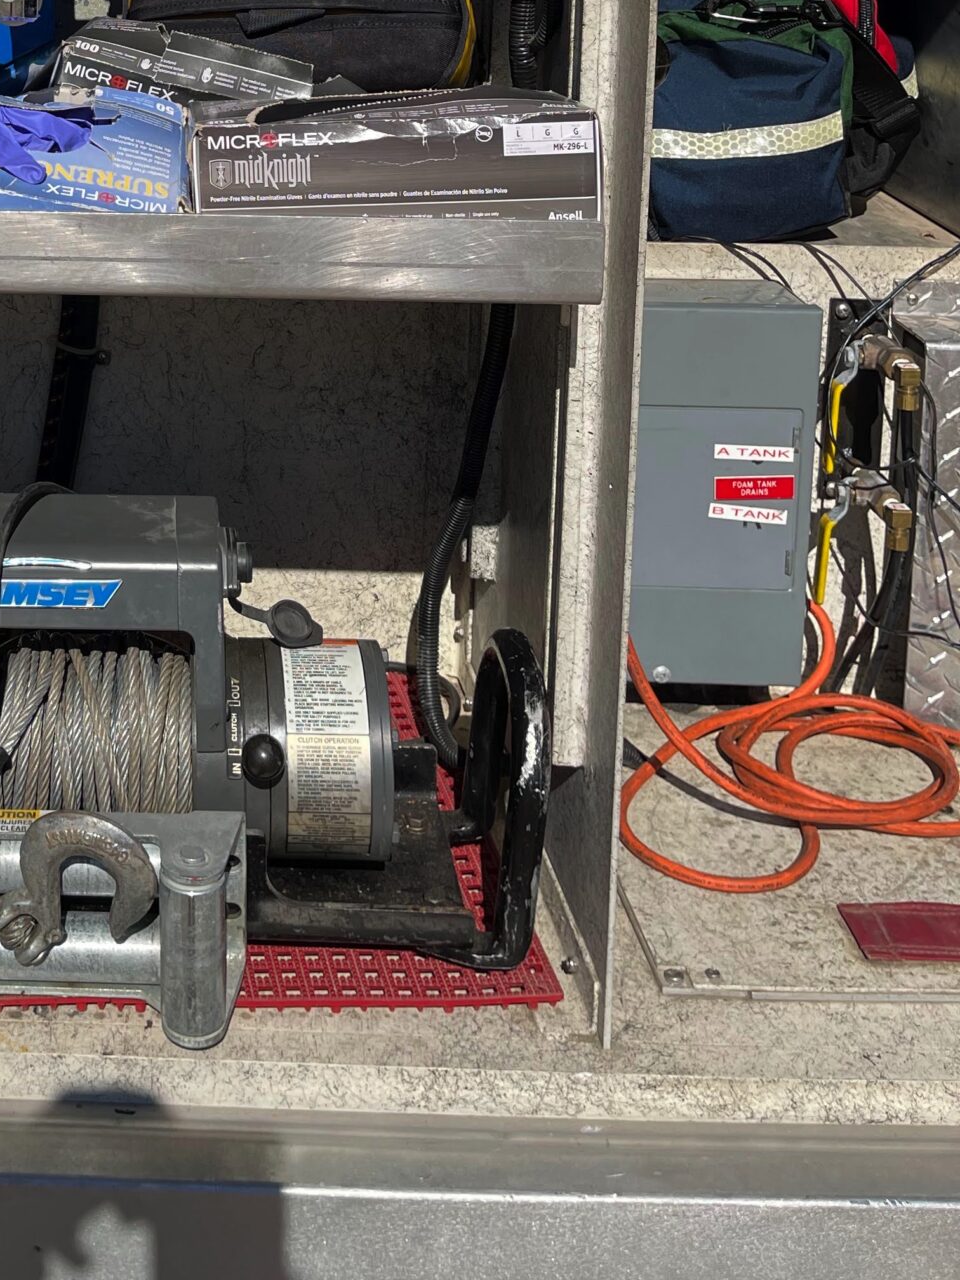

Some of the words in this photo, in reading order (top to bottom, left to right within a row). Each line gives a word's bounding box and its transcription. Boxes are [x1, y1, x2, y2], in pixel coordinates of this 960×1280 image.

[75, 40, 100, 53] 100
[64, 61, 175, 103] MICROFLEX
[156, 102, 176, 115] 50
[516, 130, 520, 138] L
[544, 128, 550, 136] G
[207, 131, 334, 150] MICROFLEX
[553, 142, 588, 151] MK-296-L
[45, 183, 167, 213] MICROFLEX
[548, 210, 584, 220] Ansell
[717, 447, 730, 456] A
[736, 448, 790, 458] TANK
[757, 480, 778, 488] TANK
[740, 488, 769, 496] DRAINS
[712, 506, 724, 515] B
[731, 507, 784, 521] TANK
[231, 677, 240, 700] OUT
[232, 762, 242, 774] IN
